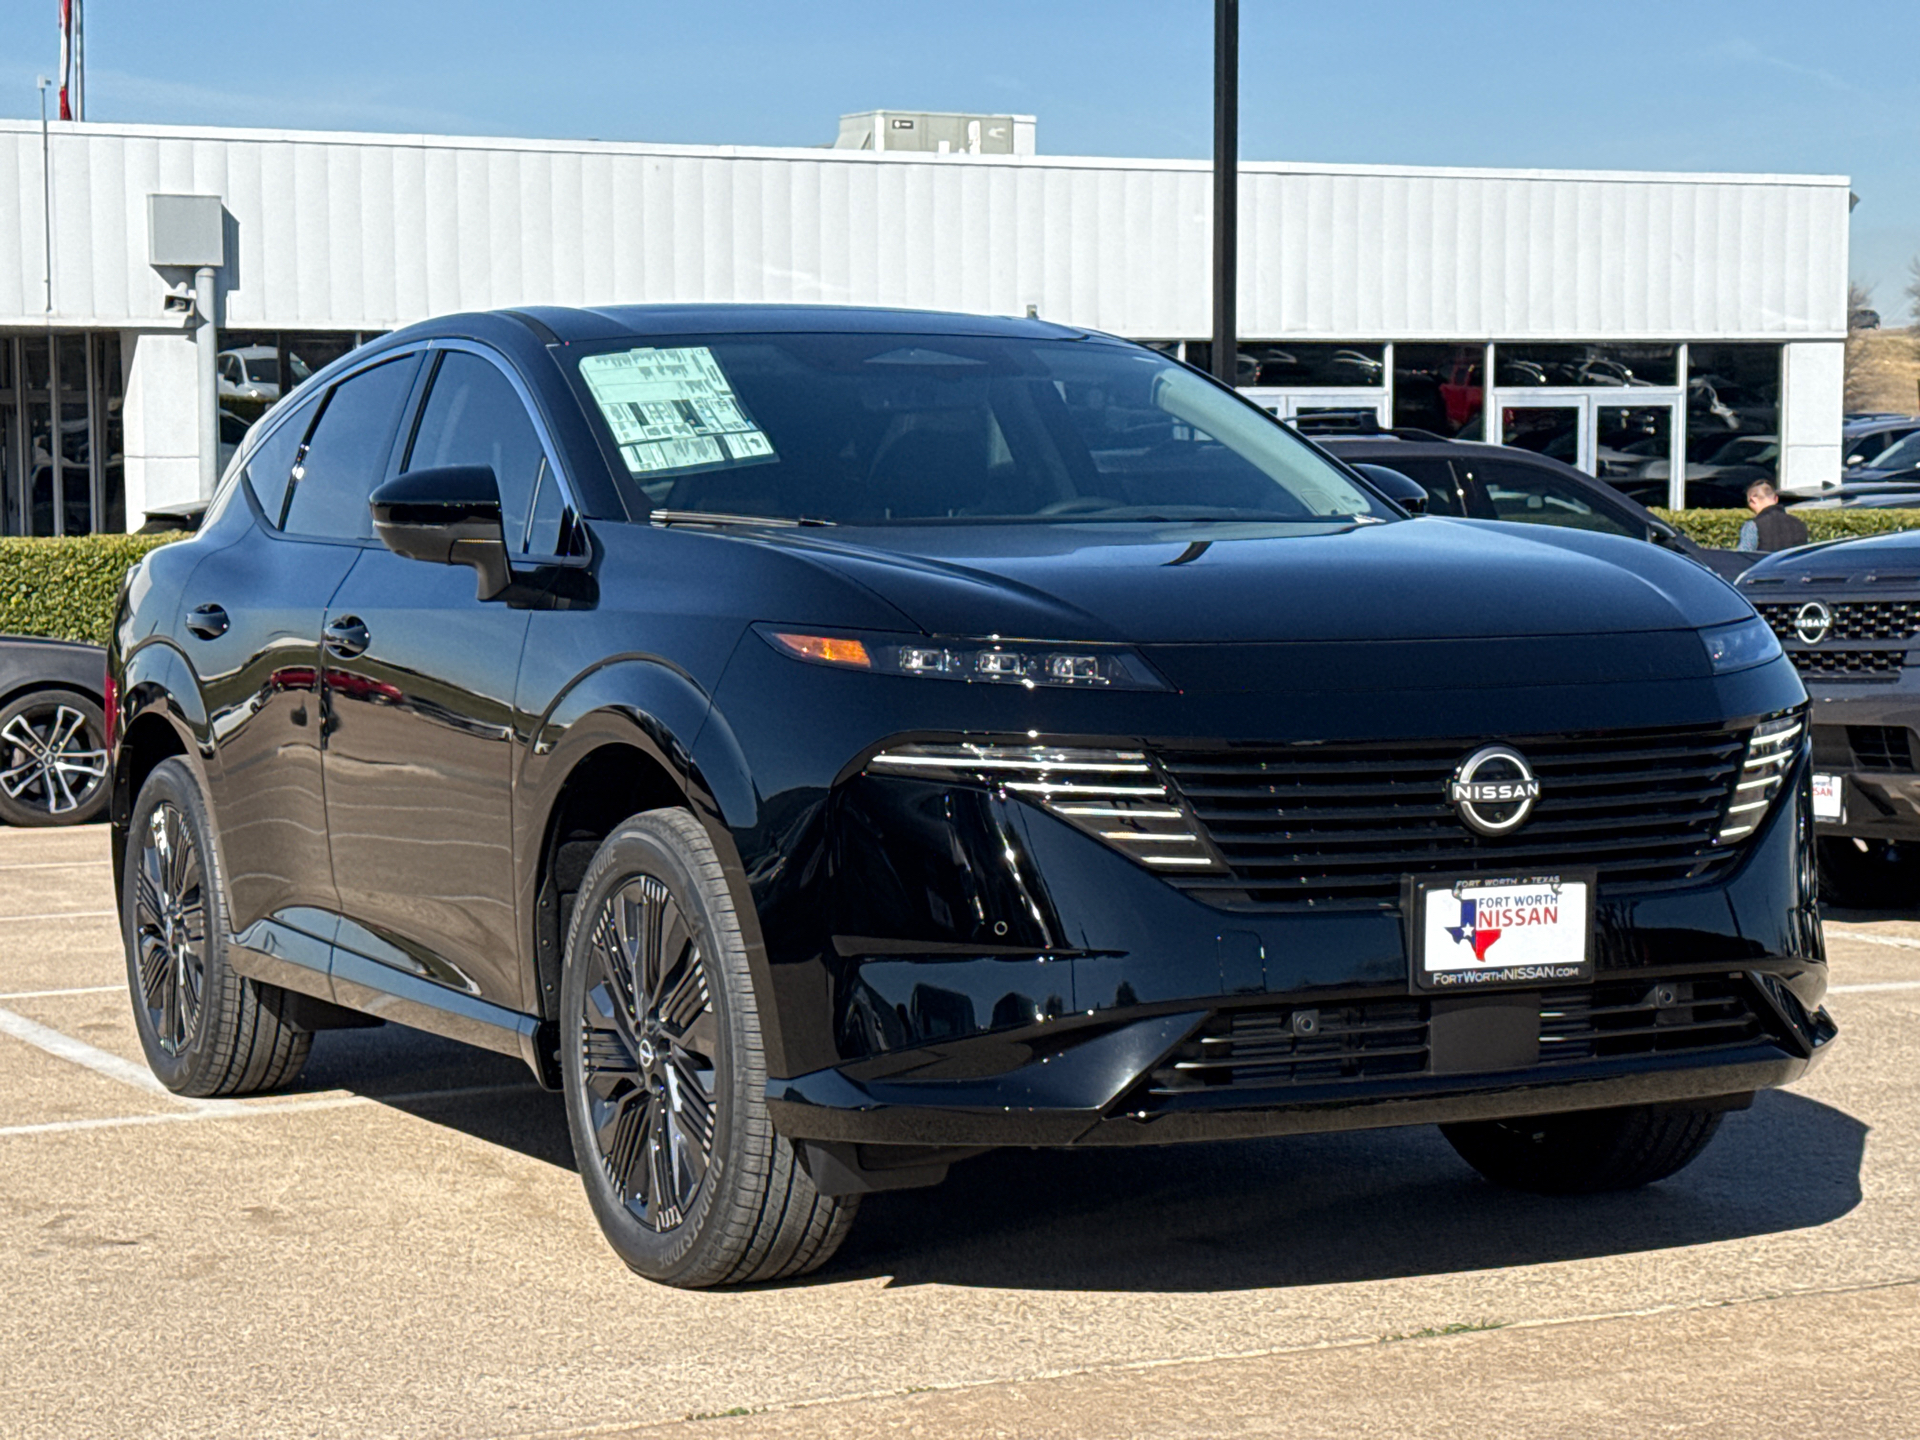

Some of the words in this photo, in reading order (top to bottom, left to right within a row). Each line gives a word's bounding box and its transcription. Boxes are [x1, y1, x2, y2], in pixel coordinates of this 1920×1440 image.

[1795, 617, 1831, 627] SSAN
[1455, 782, 1539, 799] NISSAN
[1456, 879, 1481, 888] FORT
[1484, 877, 1518, 886] WORTH
[1531, 875, 1561, 884] TEXAS
[1479, 896, 1511, 909] FORT
[1514, 894, 1558, 906] WORTH
[1478, 906, 1558, 928] NISSAN
[1433, 966, 1579, 985] FORTWORTHNISSAN.COM
